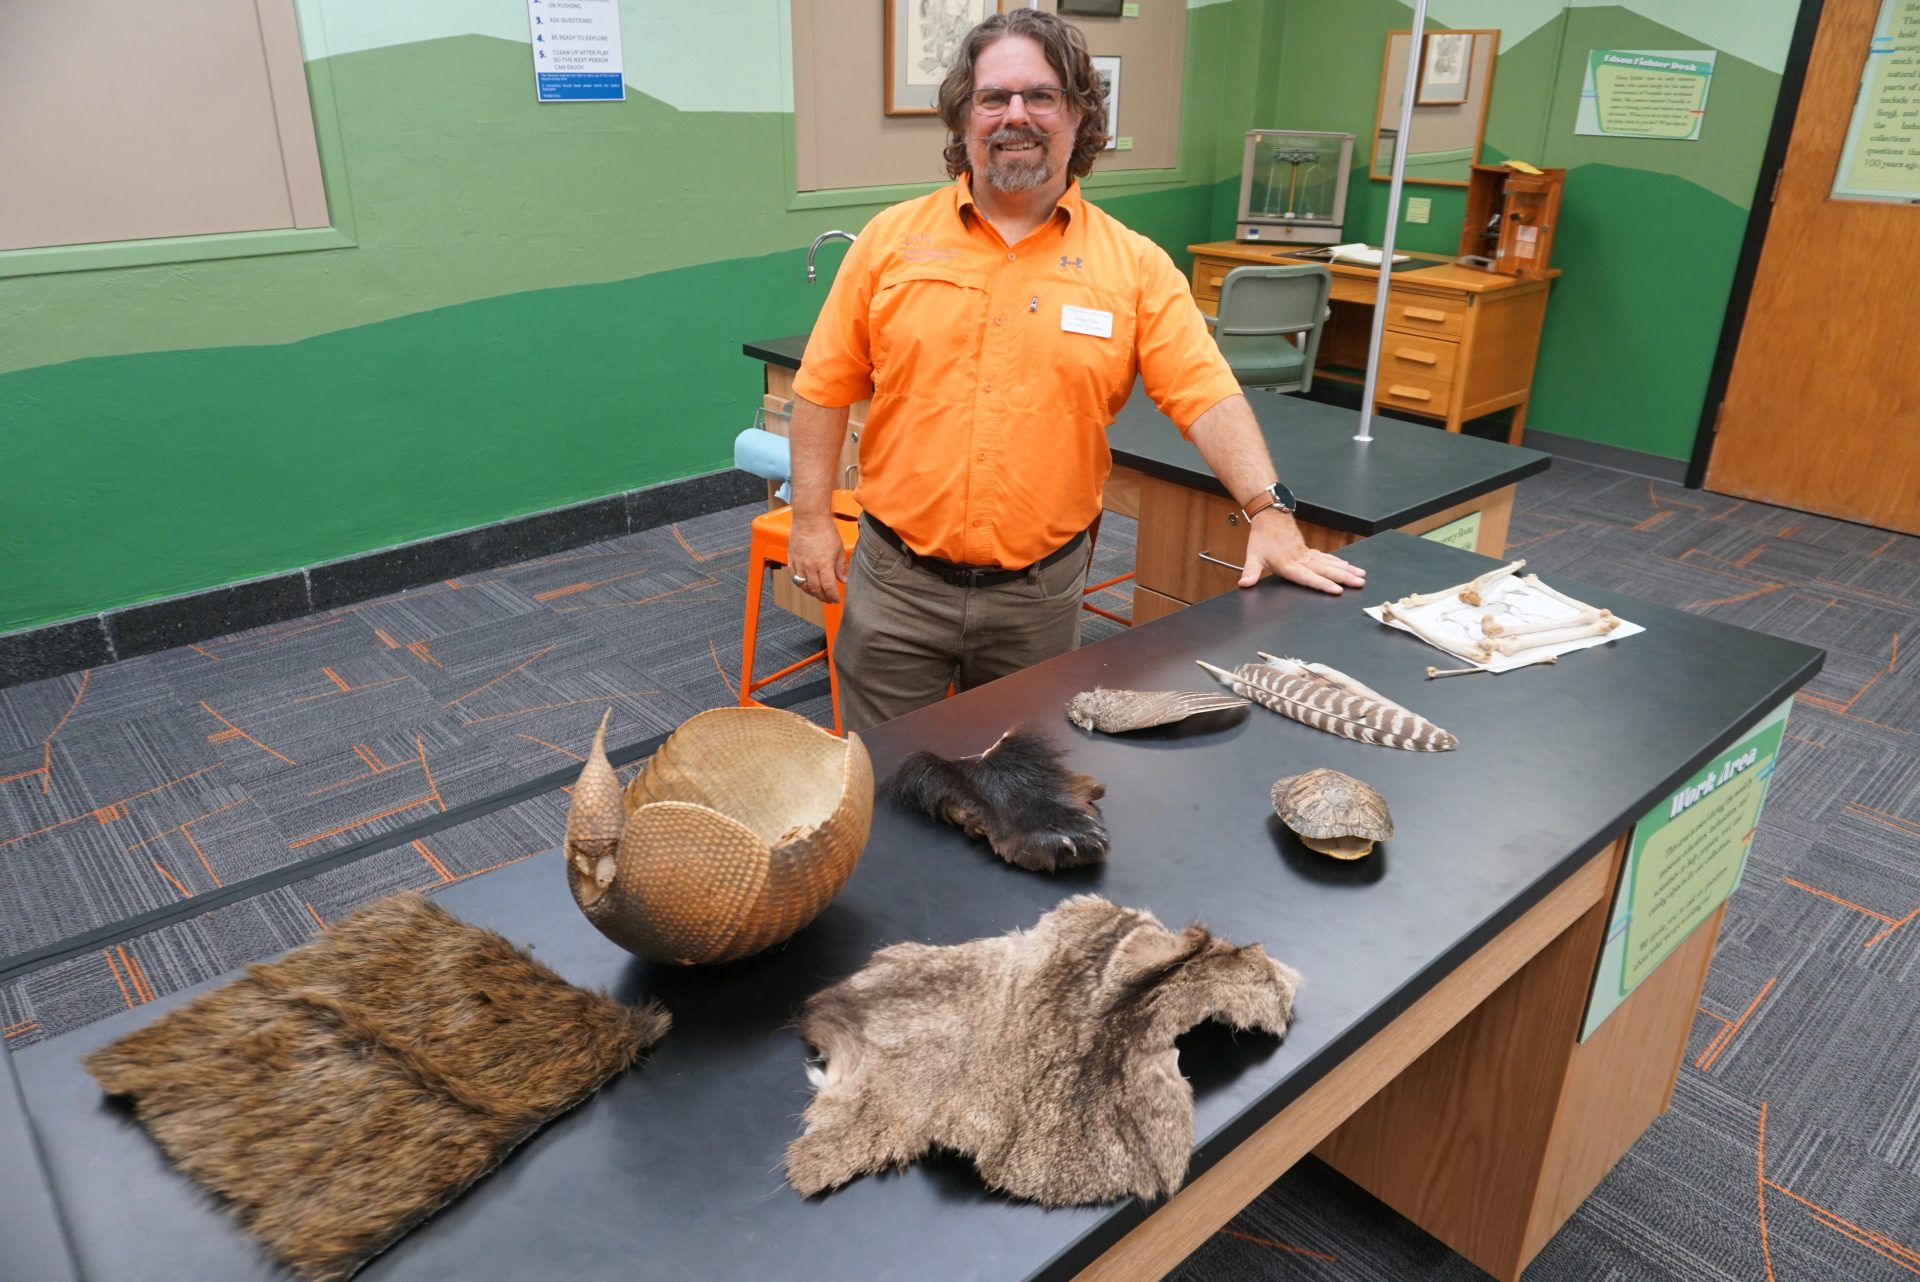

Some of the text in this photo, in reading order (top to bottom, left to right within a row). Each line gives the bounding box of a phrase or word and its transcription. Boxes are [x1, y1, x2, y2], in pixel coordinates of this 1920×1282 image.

[1670, 61, 1697, 72] Desk
[1669, 747, 1758, 819] Work Area
